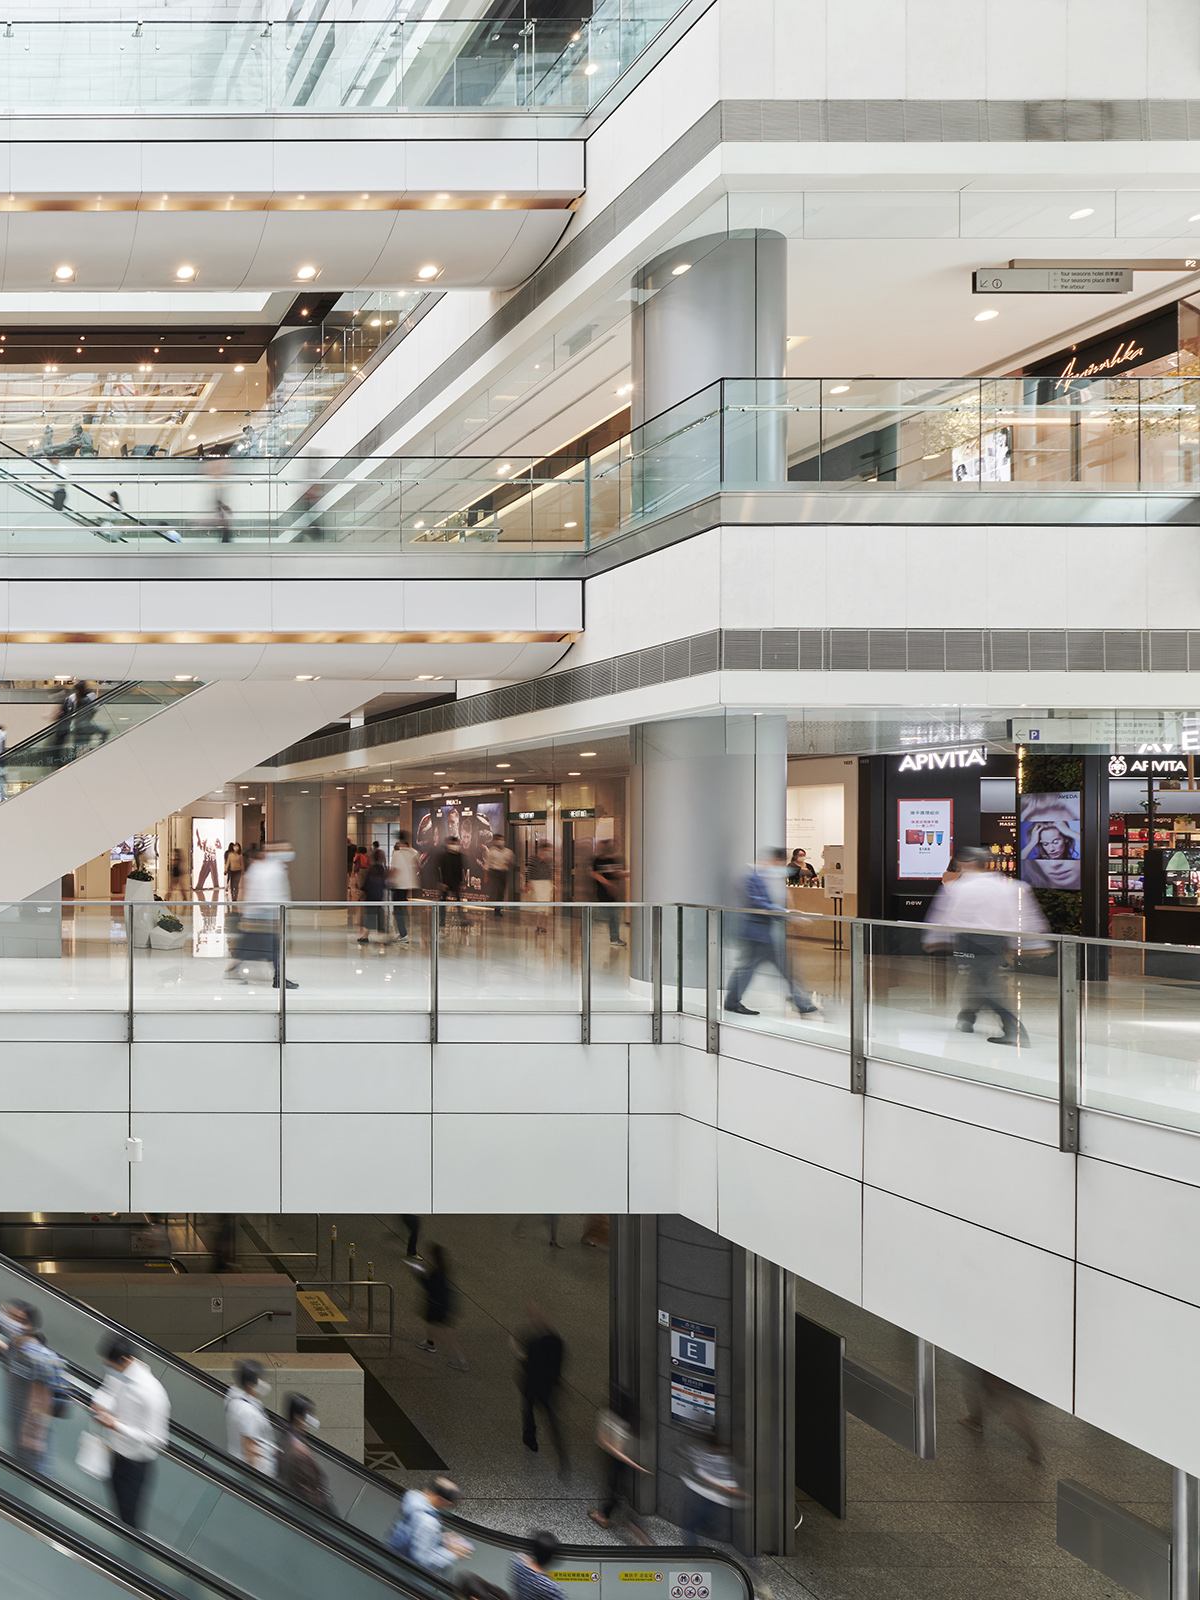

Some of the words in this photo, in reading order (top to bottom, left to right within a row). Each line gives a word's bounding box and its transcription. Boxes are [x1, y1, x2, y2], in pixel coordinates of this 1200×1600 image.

[1185, 259, 1197, 268] P2
[898, 748, 987, 772] APIVITA
[687, 1342, 698, 1359] E
